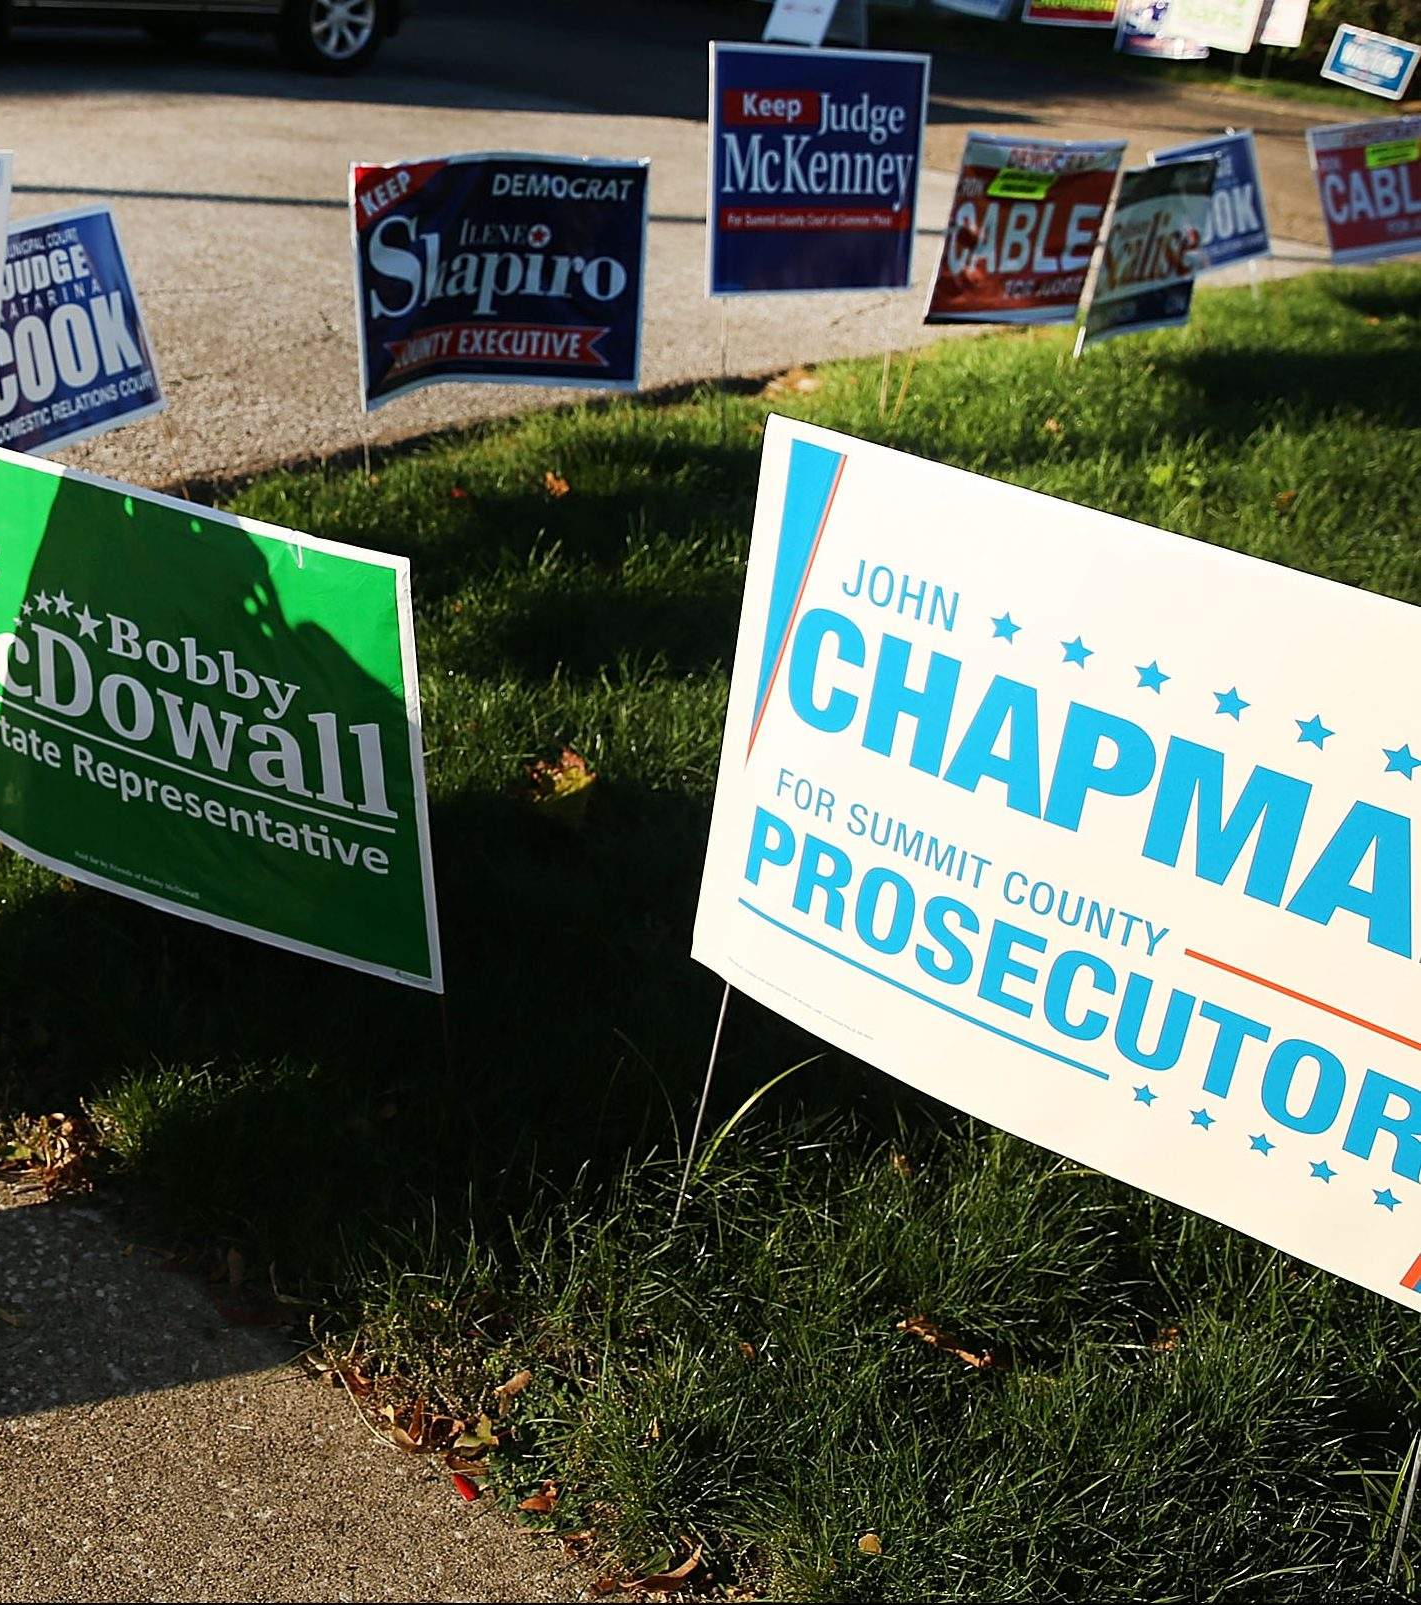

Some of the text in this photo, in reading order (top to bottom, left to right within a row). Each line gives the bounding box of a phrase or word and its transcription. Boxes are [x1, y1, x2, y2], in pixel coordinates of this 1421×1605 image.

[742, 92, 907, 145] Keep Judge
[358, 170, 411, 216] KEEP
[491, 173, 634, 201] DEMOCRAT
[721, 132, 915, 212] McKenney
[1323, 164, 1421, 226] CABL
[0, 243, 90, 301] JUDGE
[368, 215, 627, 320] Shapiro
[946, 201, 1104, 276] CABLE
[0, 278, 102, 322] ATARINA
[457, 329, 581, 359] EXECUTIVE
[51, 384, 120, 423] RELATIONS
[840, 559, 961, 633] JOHN
[106, 613, 301, 721] Bobby
[72, 743, 391, 876] Representative
[786, 606, 1421, 963] CHAPMA
[775, 767, 1172, 958] FOR SUMMIT COUNTY
[743, 805, 1421, 1185] PROSECUTOR
